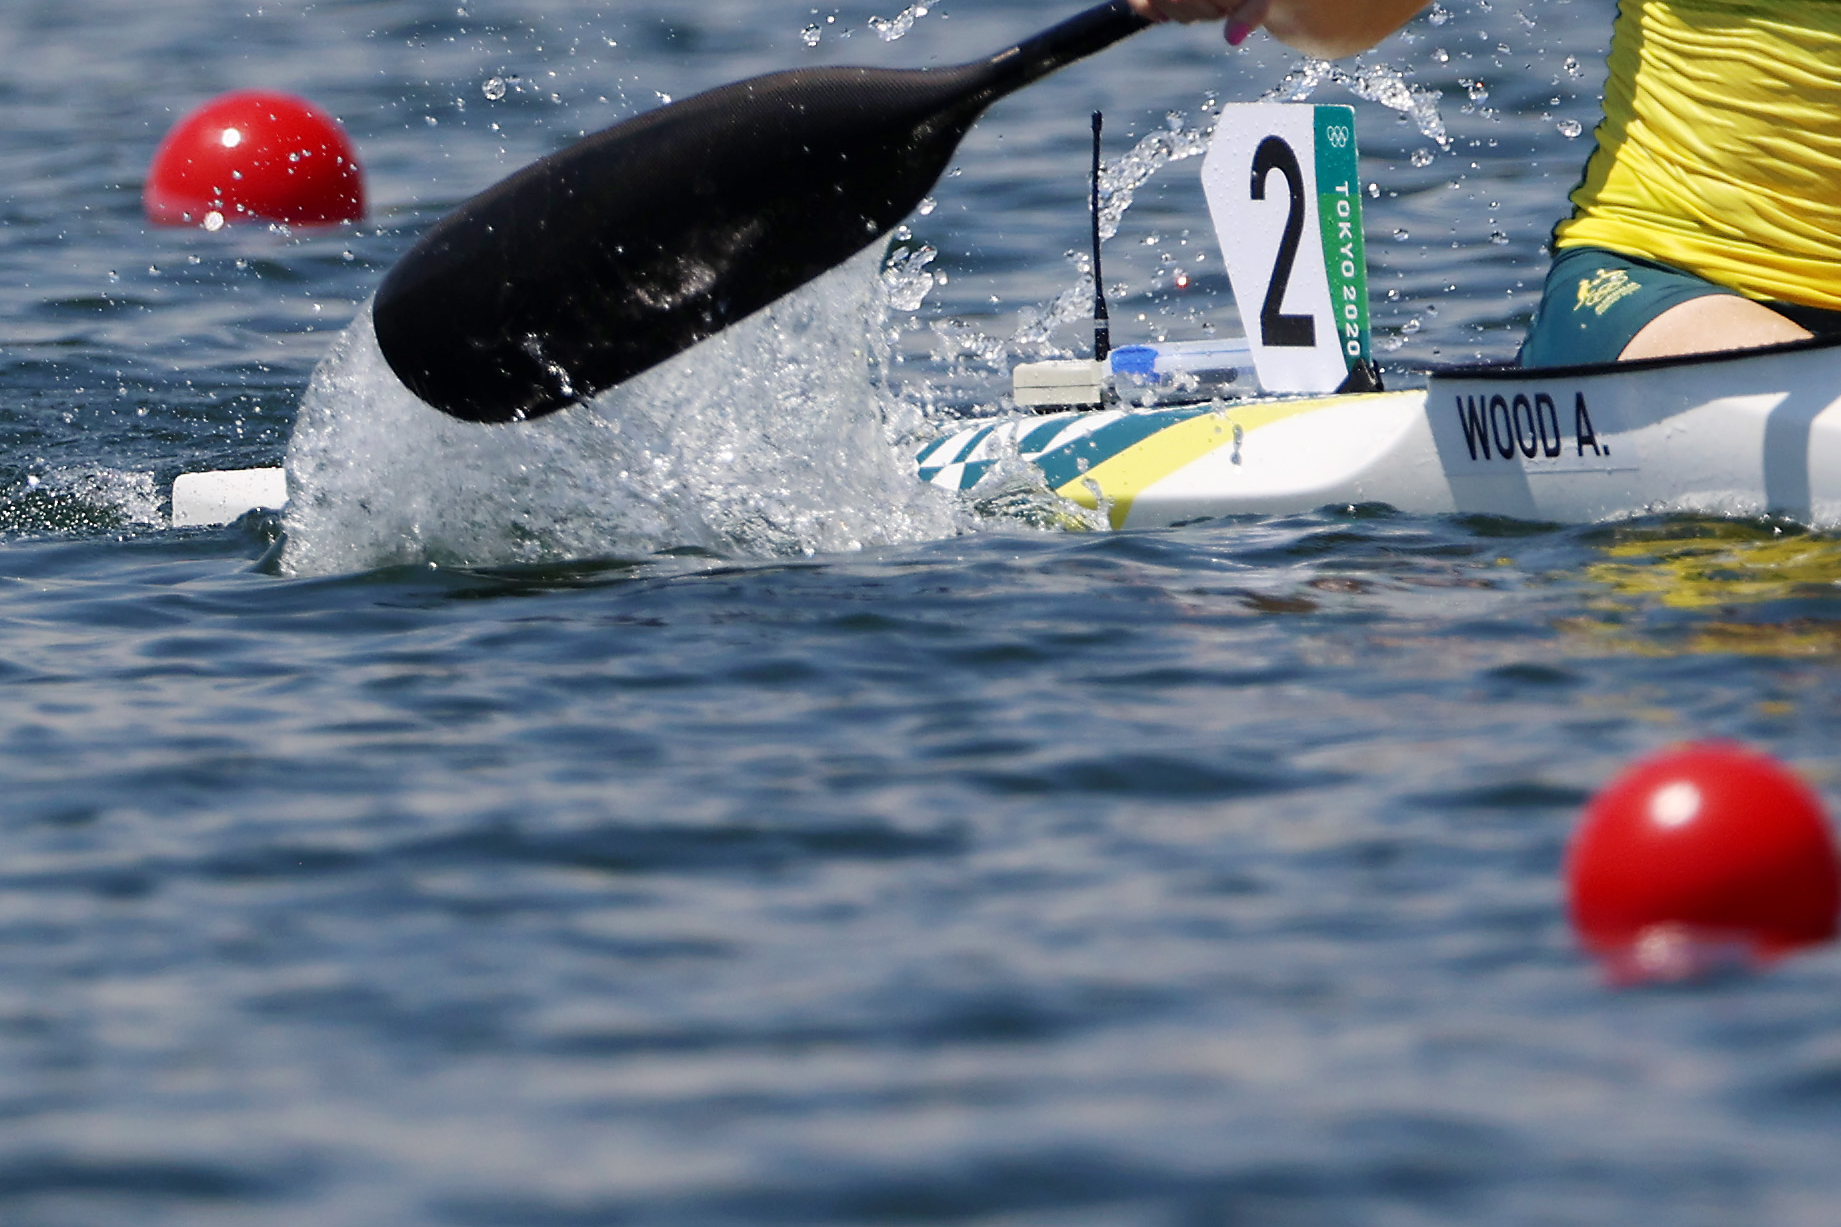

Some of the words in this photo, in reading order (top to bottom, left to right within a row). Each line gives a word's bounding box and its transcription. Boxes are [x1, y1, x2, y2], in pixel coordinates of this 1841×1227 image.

[1251, 135, 1317, 347] 2
[1335, 181, 1356, 278] TOKYO
[1342, 285, 1361, 357] 2020
[1456, 392, 1562, 461] WOOD
[1575, 390, 1611, 457] A.
